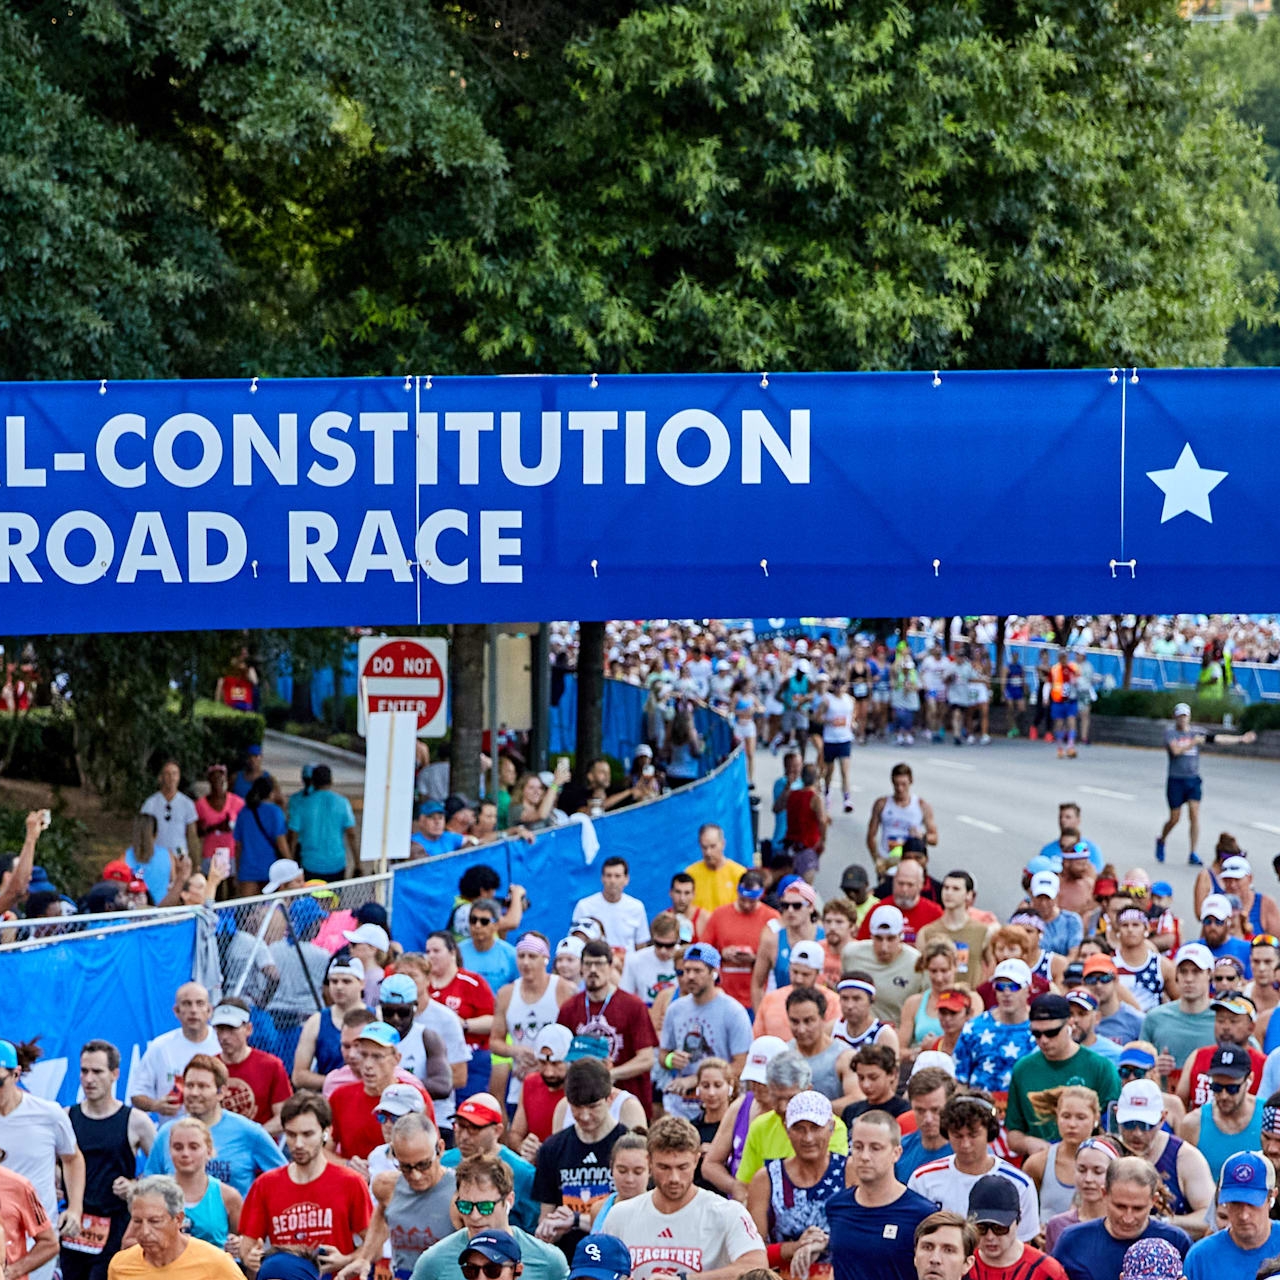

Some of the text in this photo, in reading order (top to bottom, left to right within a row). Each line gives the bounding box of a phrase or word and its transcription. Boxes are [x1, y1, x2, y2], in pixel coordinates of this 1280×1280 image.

[288, 508, 524, 585] RACE
[373, 656, 433, 674] DO NOT
[377, 700, 427, 716] ENTER
[272, 1207, 333, 1234] GEORGIA
[629, 1247, 702, 1271] PEACHTREE
